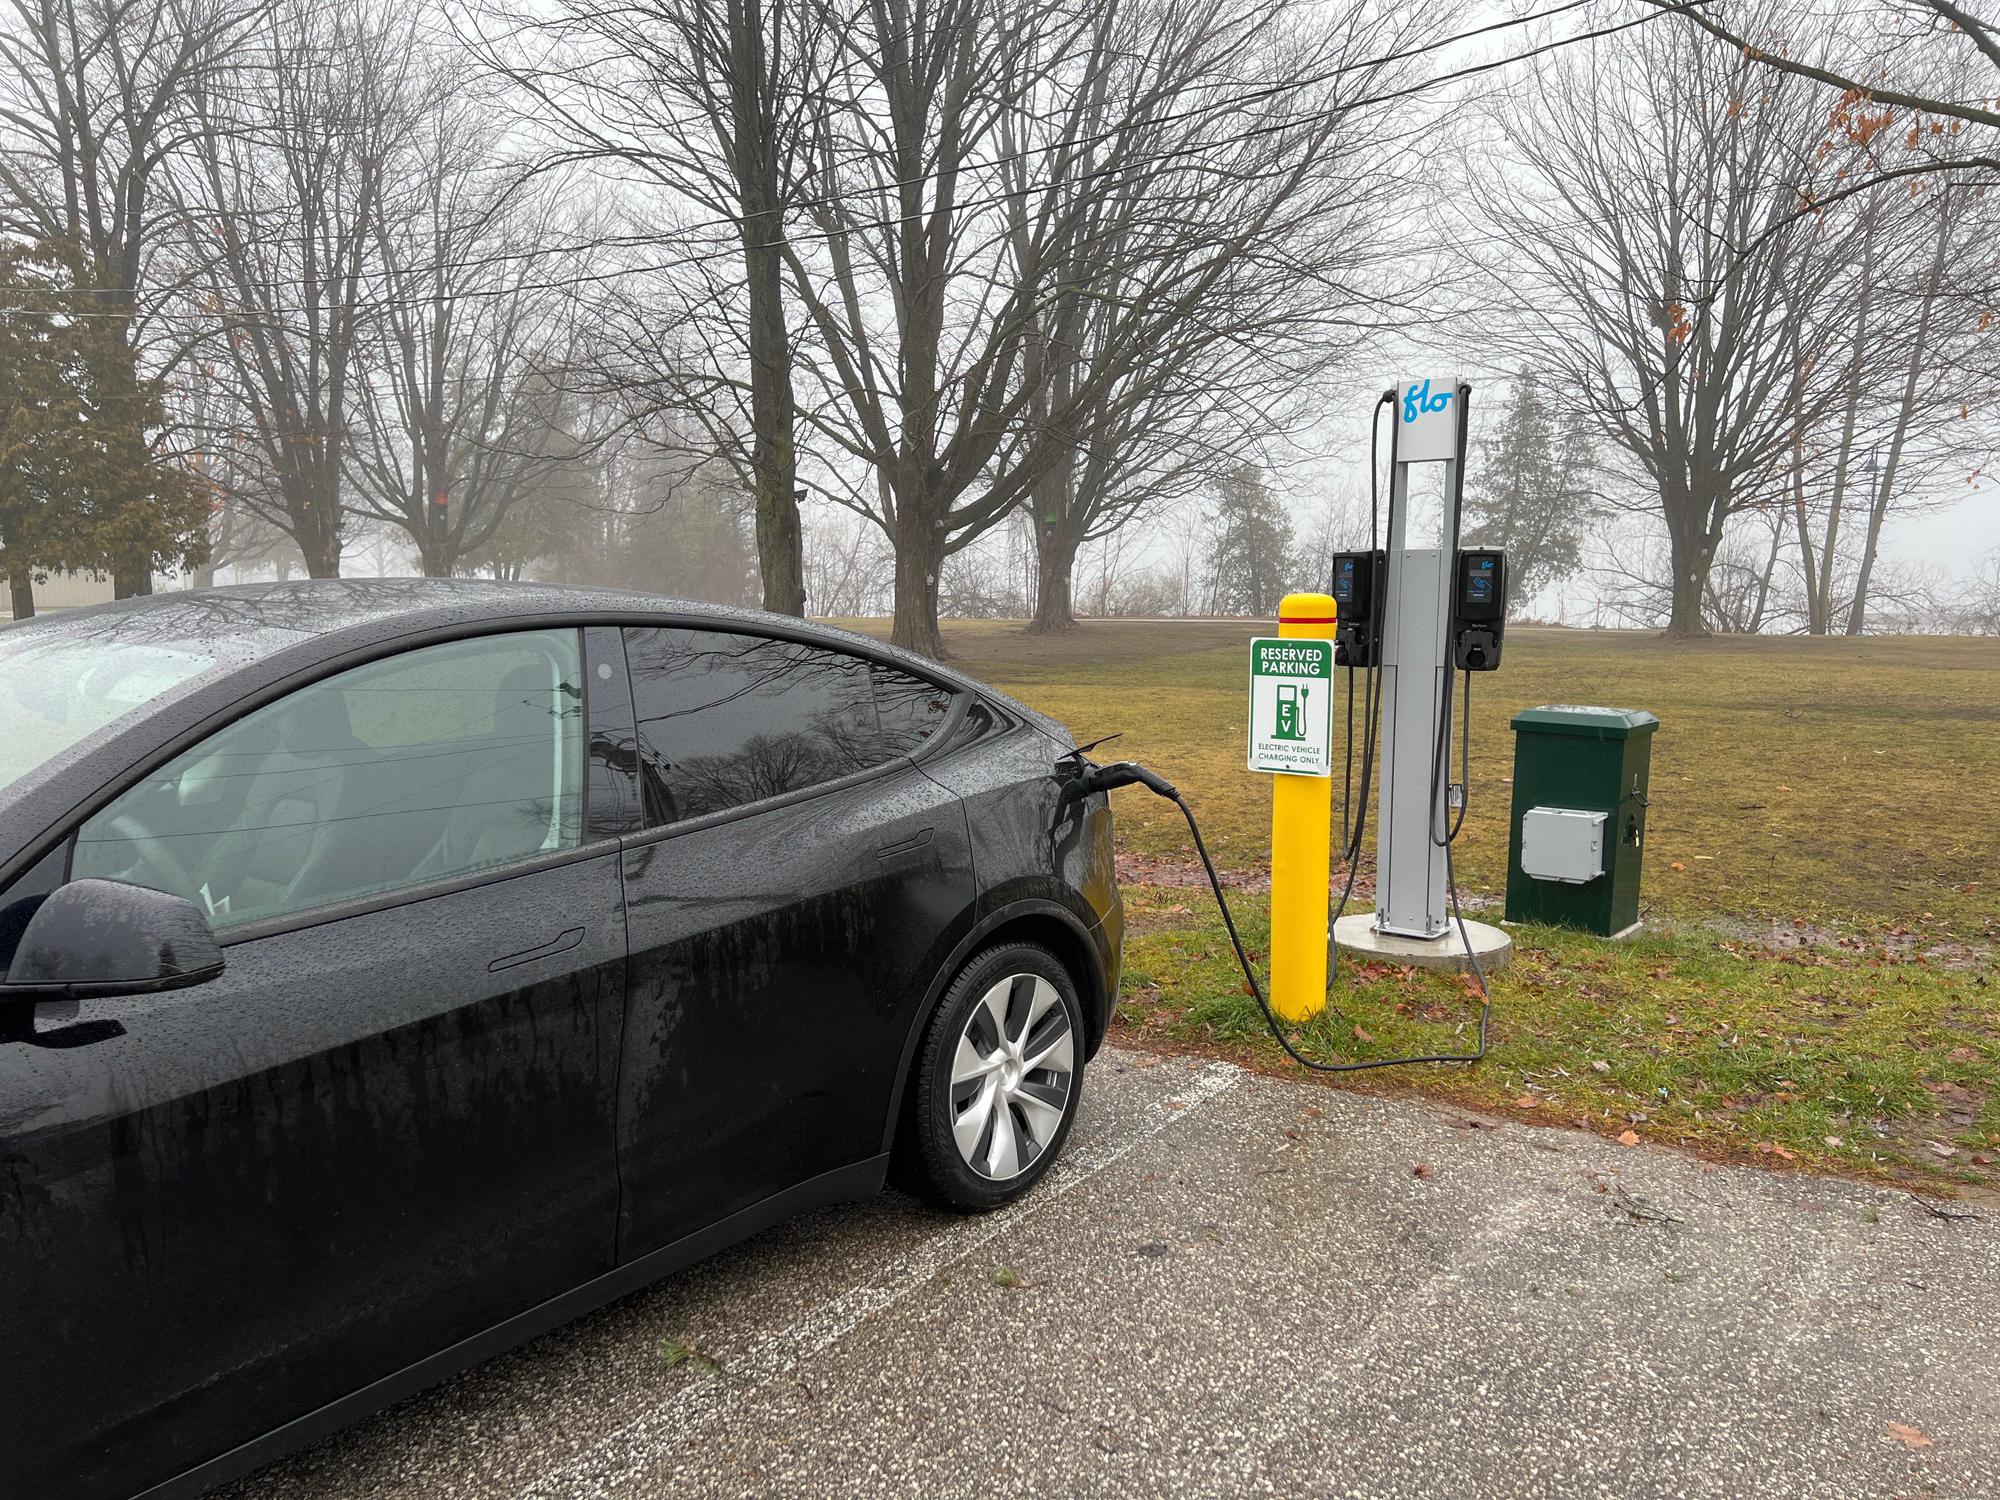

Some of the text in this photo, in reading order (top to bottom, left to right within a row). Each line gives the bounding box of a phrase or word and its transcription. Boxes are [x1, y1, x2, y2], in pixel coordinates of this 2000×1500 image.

[1403, 379, 1455, 423] flo
[1260, 647, 1322, 661] RESERVED
[1262, 661, 1321, 675] PARKING
[1258, 743, 1321, 755] ELECTRIC VEHICLE
[1258, 752, 1320, 764] CHARGING ONLY
